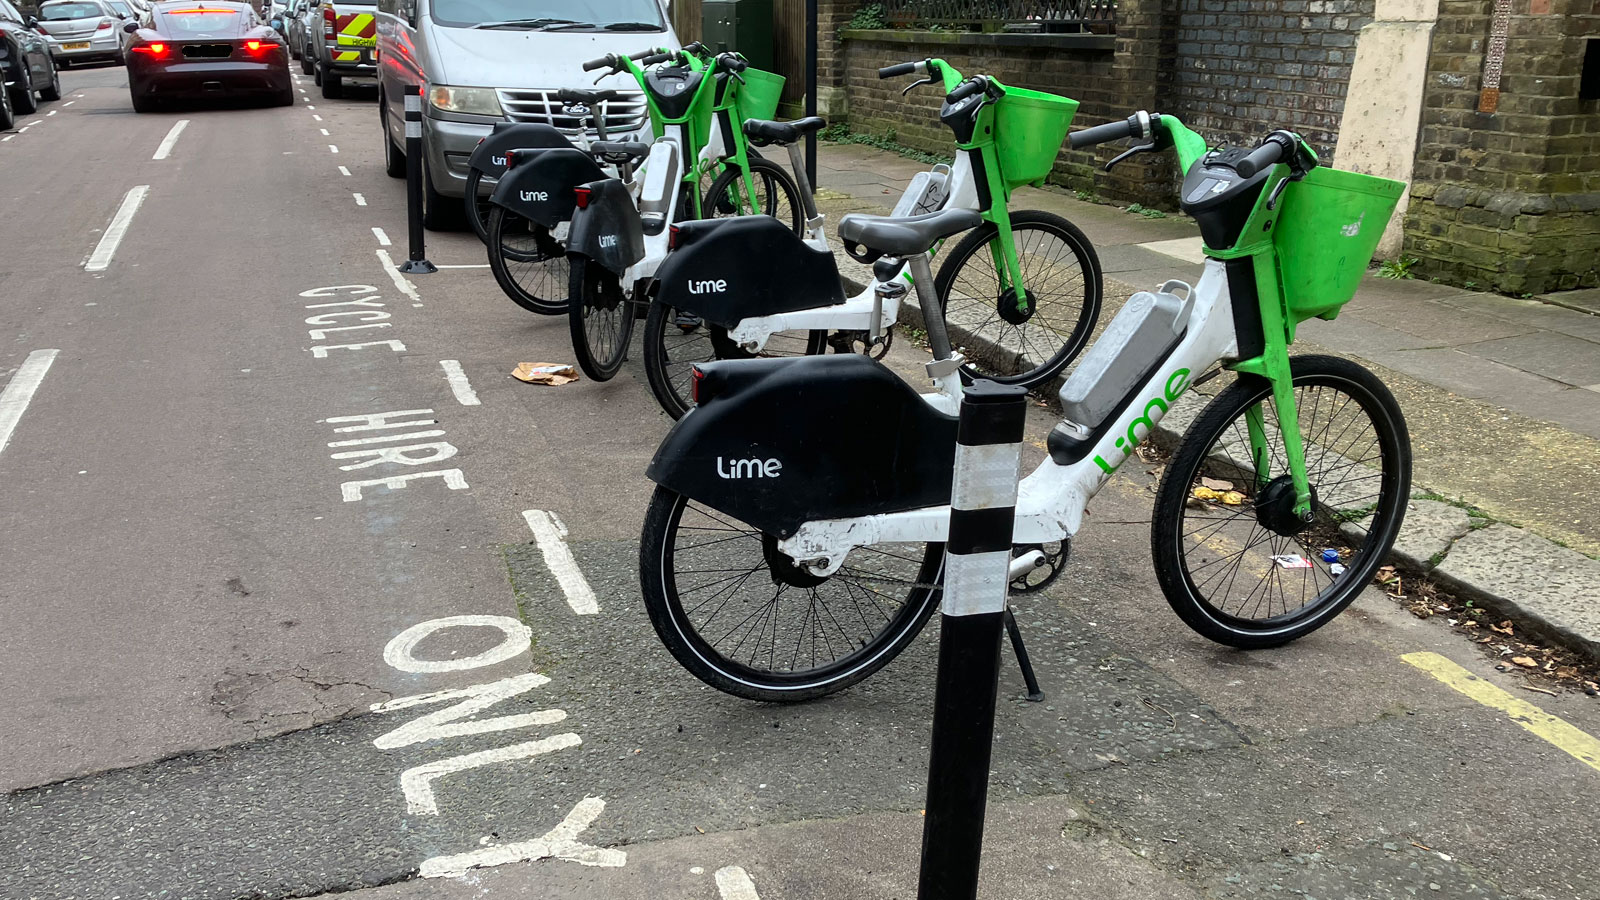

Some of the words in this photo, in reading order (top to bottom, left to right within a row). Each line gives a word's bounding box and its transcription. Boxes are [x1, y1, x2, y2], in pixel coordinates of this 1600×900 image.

[492, 156, 507, 165] Lim
[520, 191, 548, 201] Lime
[598, 235, 616, 247] Lime
[688, 279, 727, 294] Lime
[298, 284, 407, 358] CYCLE
[1092, 367, 1191, 475] Lime
[325, 408, 470, 502] HIRE
[716, 456, 783, 479] Lime
[369, 614, 627, 879] ONLY
